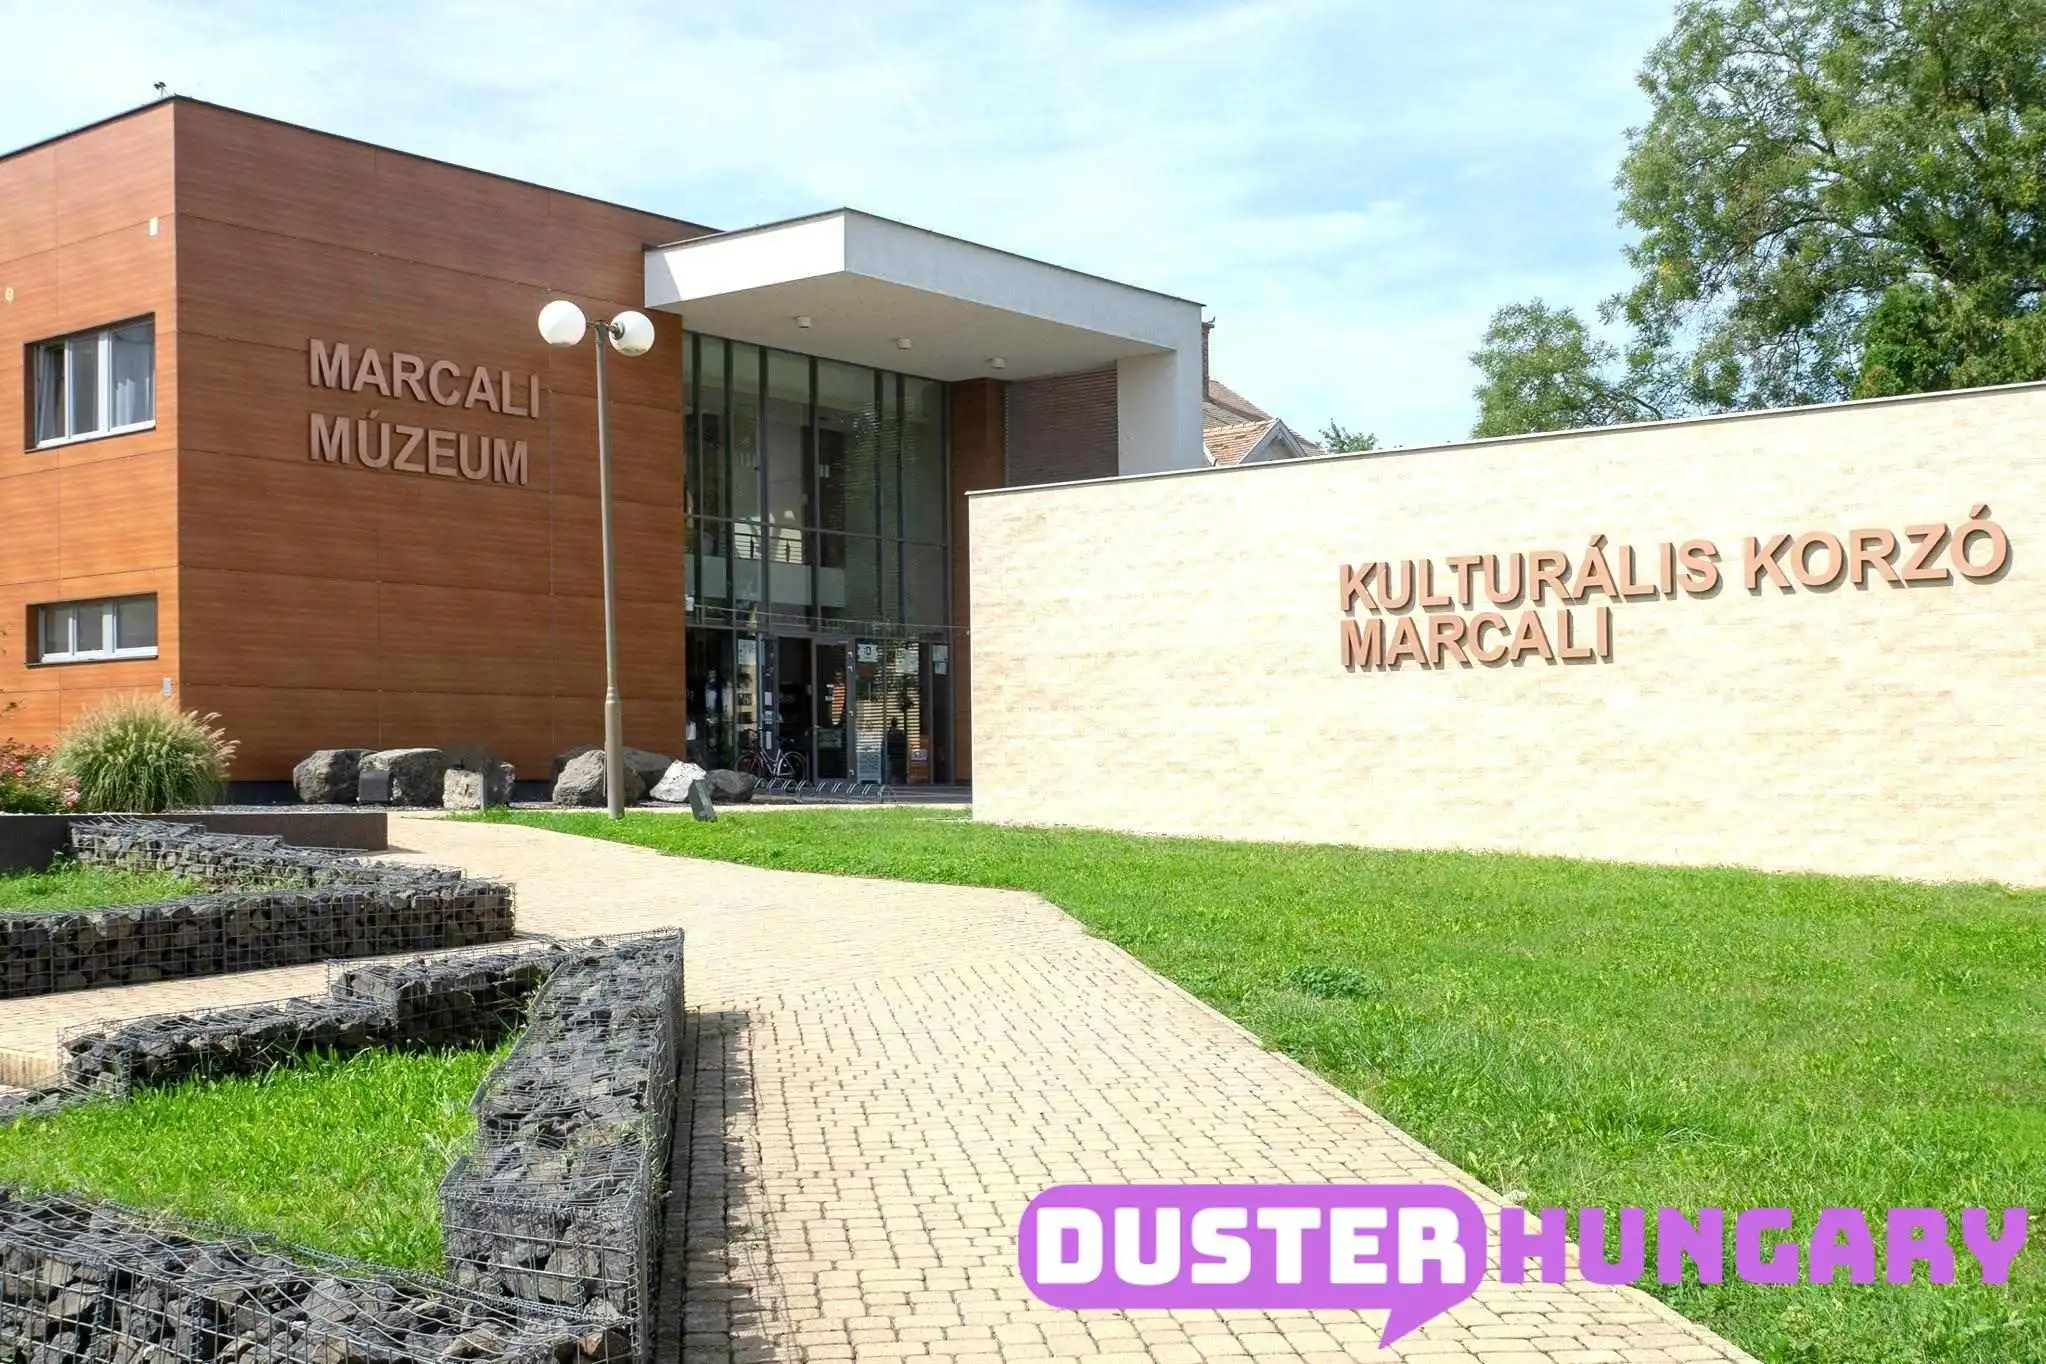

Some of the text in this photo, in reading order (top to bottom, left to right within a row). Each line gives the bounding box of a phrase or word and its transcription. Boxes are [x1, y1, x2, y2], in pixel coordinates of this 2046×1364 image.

[308, 338, 540, 419] MARCALI
[309, 408, 528, 486] MÚZEUM
[1340, 504, 2011, 612] KULTURÁLIS KORZÓ
[1340, 607, 1615, 671] MARCALI
